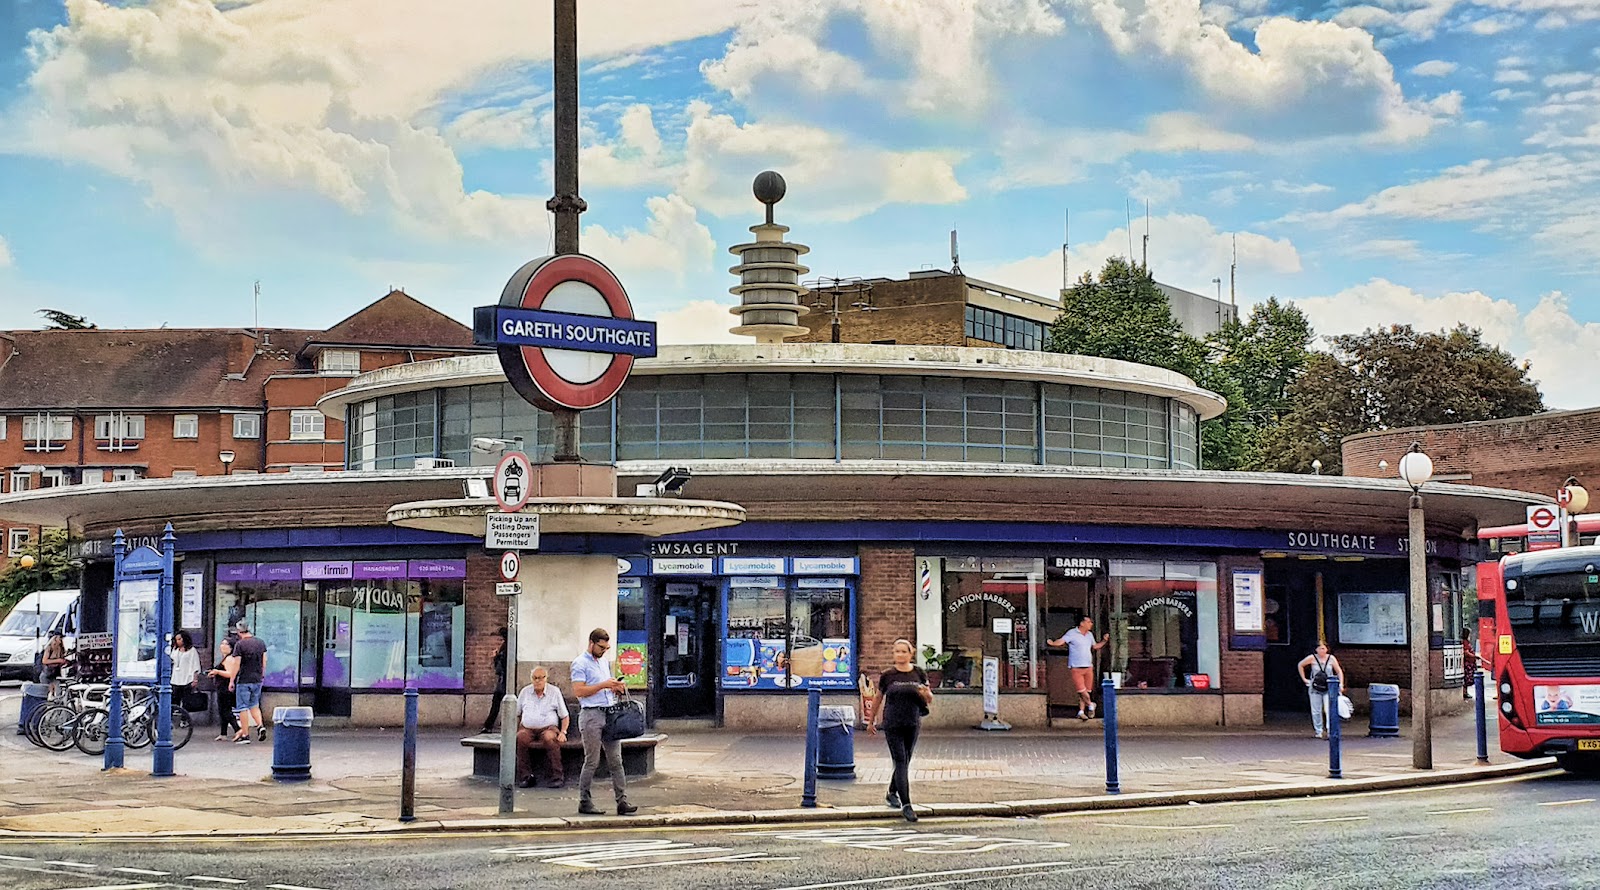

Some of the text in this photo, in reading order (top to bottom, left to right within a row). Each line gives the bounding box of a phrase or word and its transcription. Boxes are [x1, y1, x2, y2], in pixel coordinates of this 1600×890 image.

[502, 319, 651, 347] GARETH SOUTHGATE
[1557, 489, 1569, 502] H
[489, 515, 513, 523] Picking
[491, 523, 515, 531] Setting
[1288, 532, 1437, 553] SOUTHGATE STON
[504, 559, 515, 572] 10
[658, 561, 704, 571] Lycamobile
[729, 561, 776, 571] Lycamobile
[800, 561, 846, 571] Lycamobile
[1055, 558, 1101, 568] BARBER
[1064, 568, 1093, 577] SHOP
[949, 593, 1016, 613] STATION BARBERS
[1137, 597, 1193, 618] STATION BARBERS
[1580, 610, 1600, 634] W
